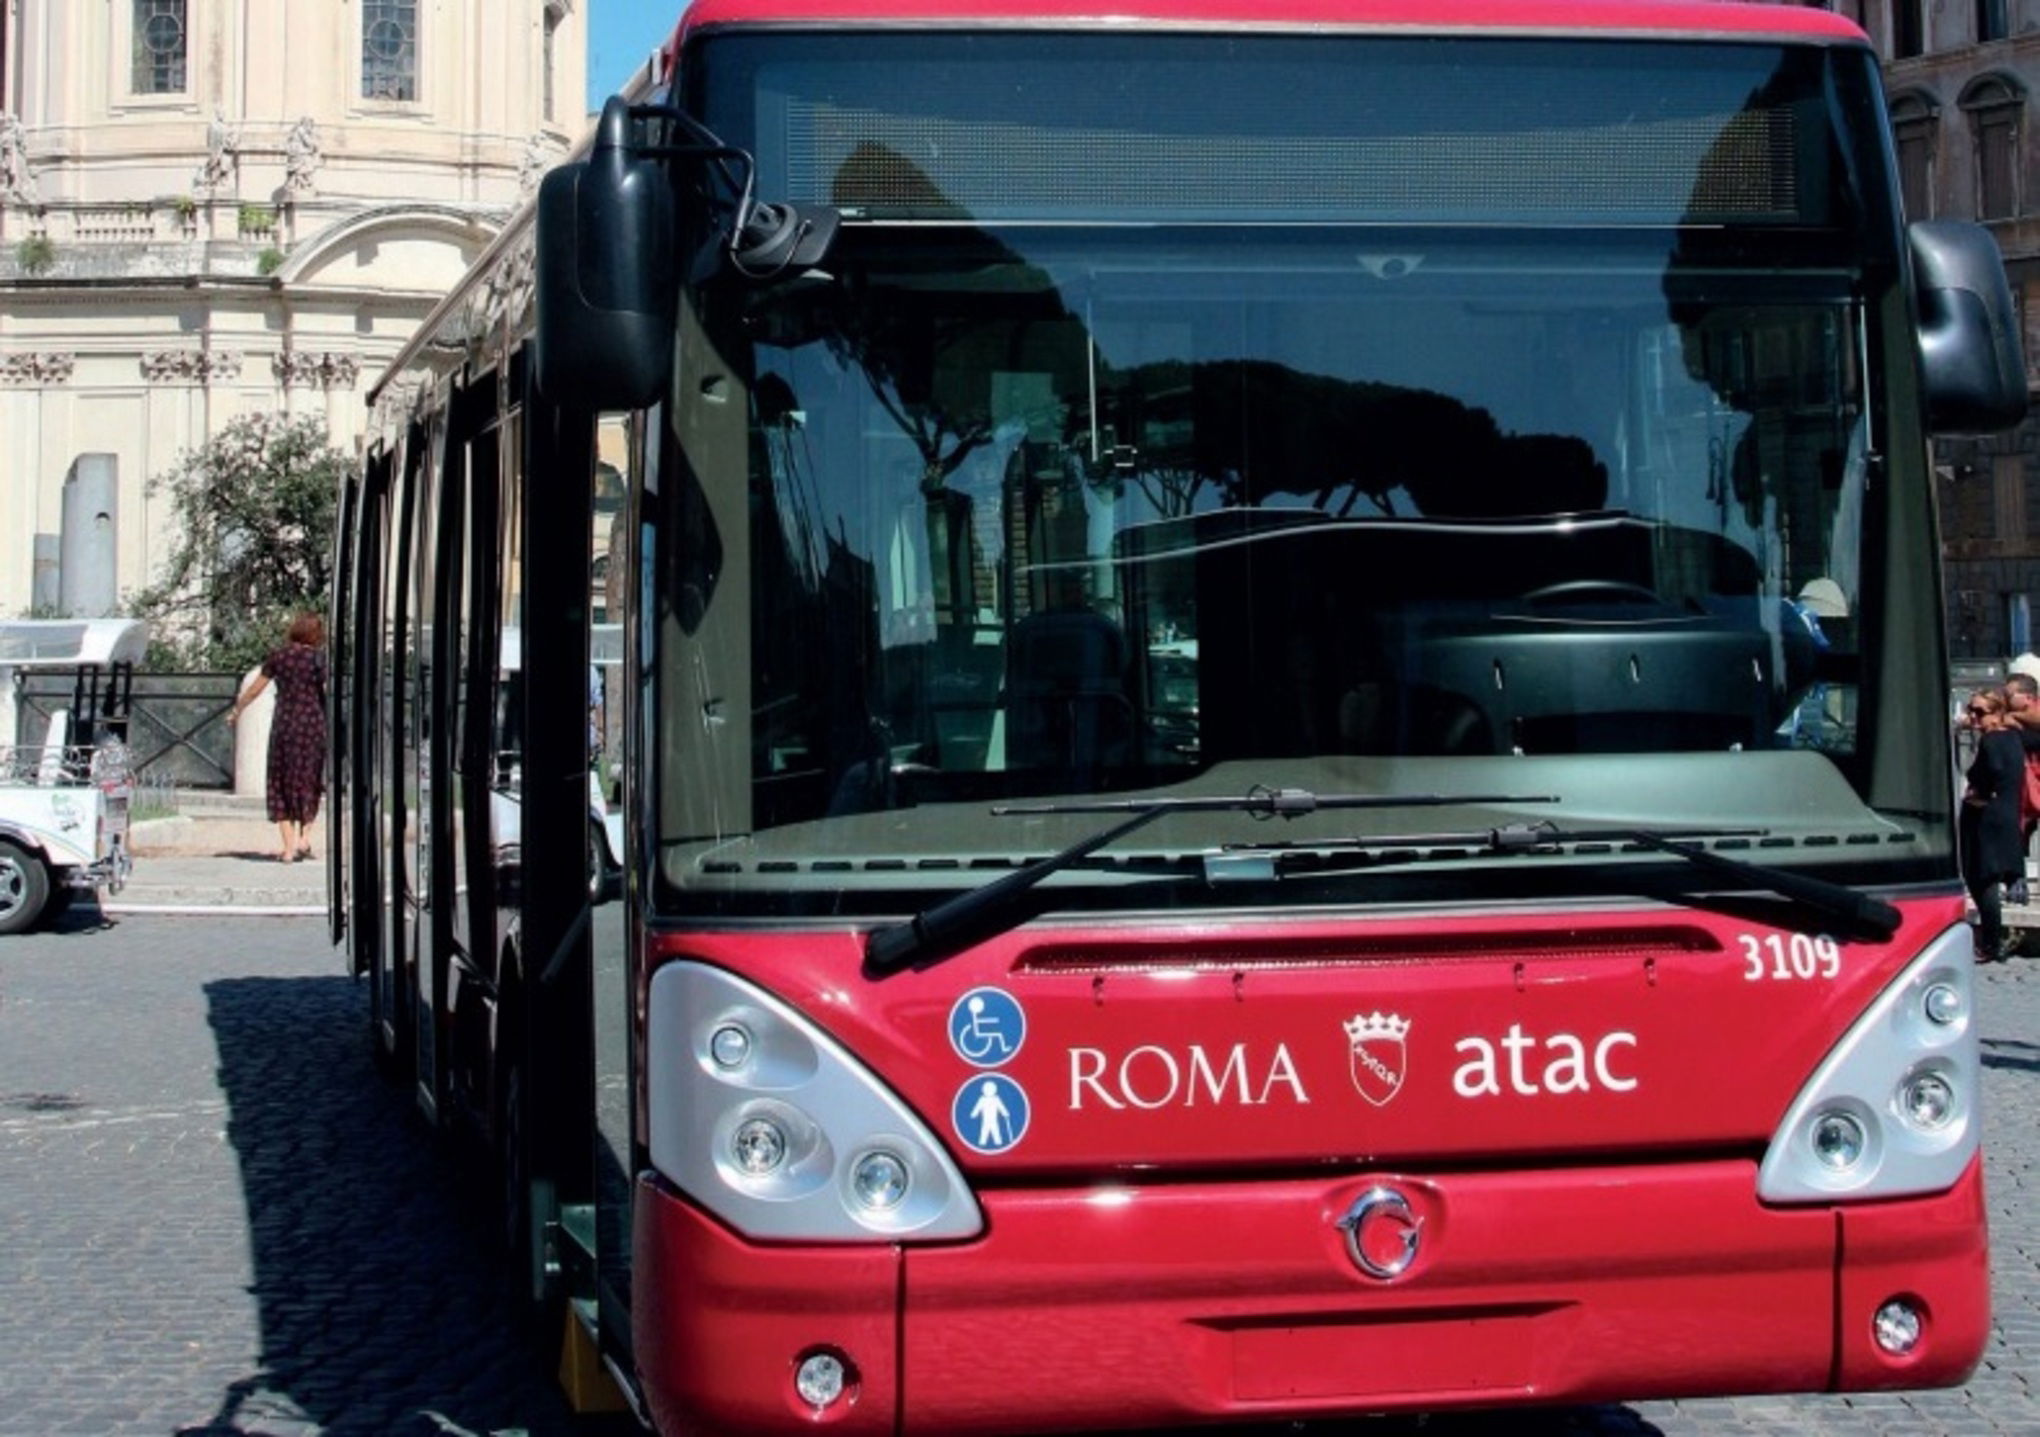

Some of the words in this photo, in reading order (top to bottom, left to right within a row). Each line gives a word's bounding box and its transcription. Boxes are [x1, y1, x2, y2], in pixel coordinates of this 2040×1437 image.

[1737, 933, 1841, 980] 3109
[1068, 1043, 1309, 1110] ROMA
[1452, 1023, 1638, 1097] atac
